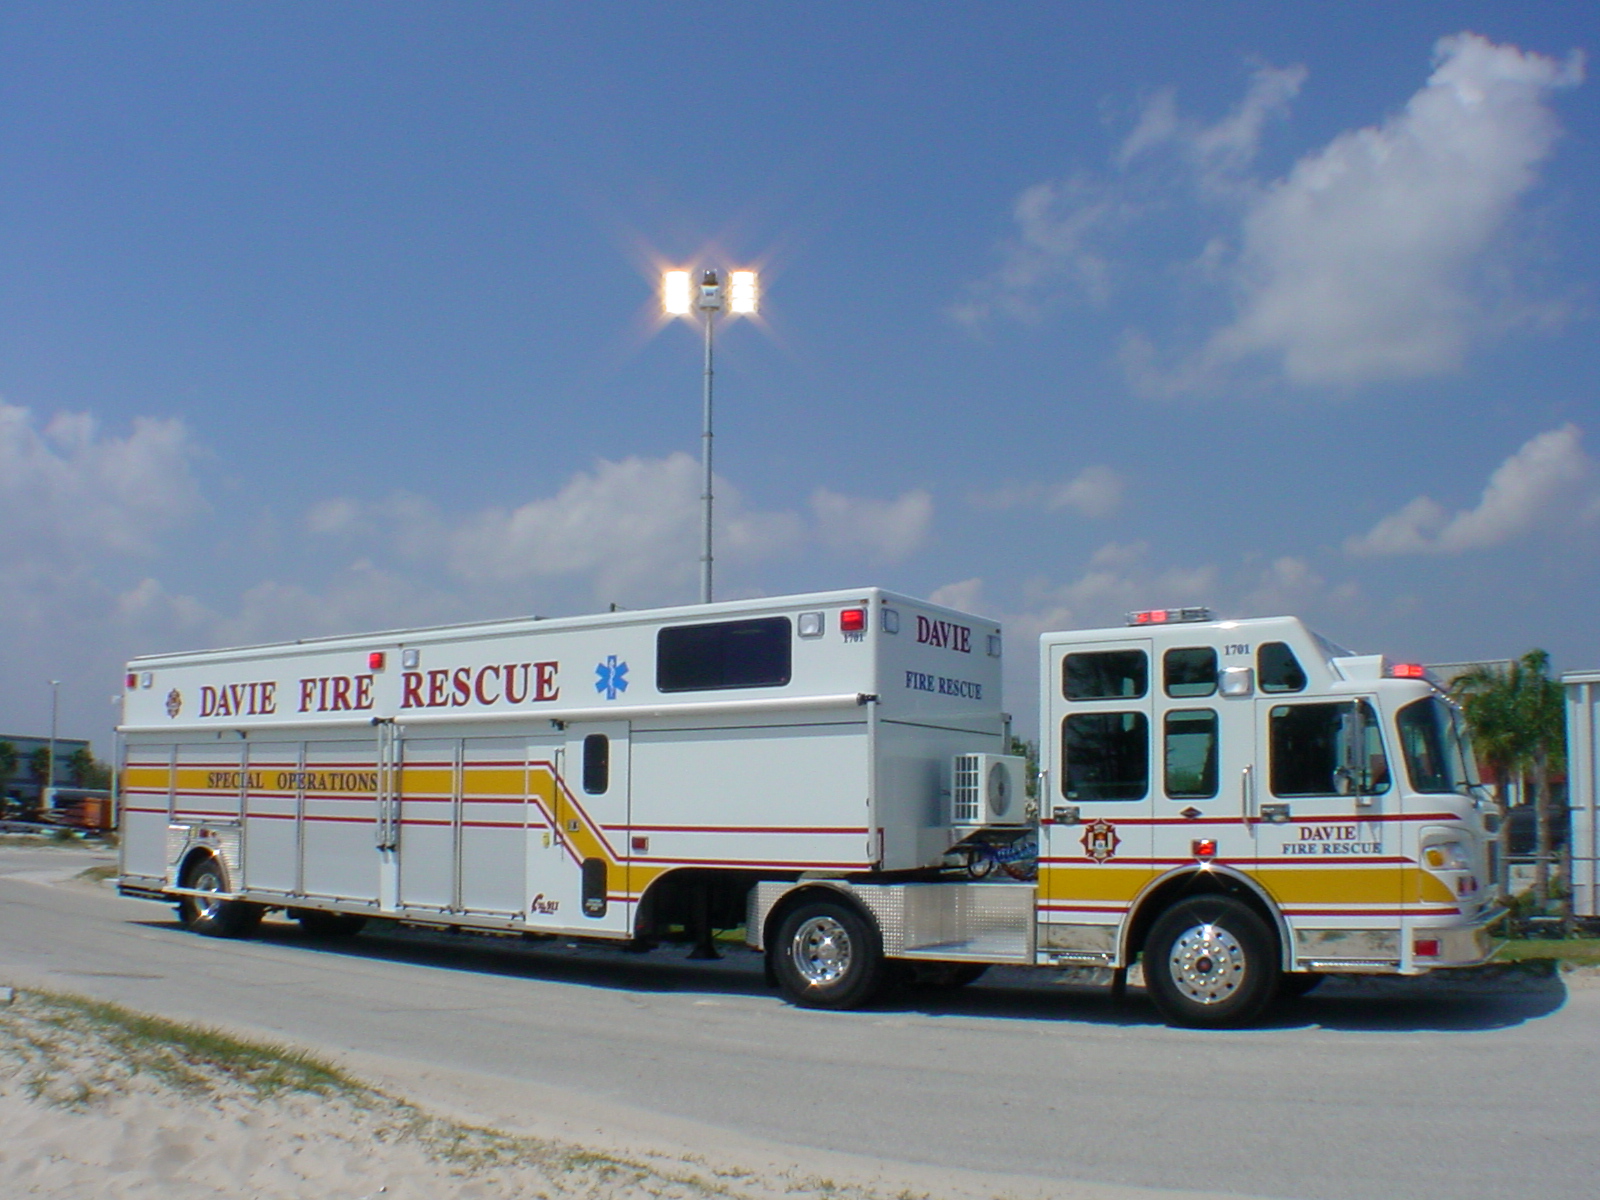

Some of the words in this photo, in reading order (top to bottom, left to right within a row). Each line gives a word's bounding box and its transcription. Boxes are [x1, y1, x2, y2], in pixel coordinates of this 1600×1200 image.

[843, 633, 864, 643] 1701
[916, 615, 972, 653] DAVIE
[1224, 643, 1250, 656] 1701
[199, 681, 277, 718] DAVIE
[298, 674, 375, 713] FIRE
[400, 660, 560, 708] RESCUE
[905, 670, 935, 693] FIRE
[938, 676, 983, 700] RESCUE
[207, 772, 265, 789] SPECIAL
[276, 772, 379, 792] OPERATIONS
[1299, 825, 1356, 841] DAVIE
[1282, 843, 1317, 855] FIRE
[1321, 842, 1382, 855] RESCUE
